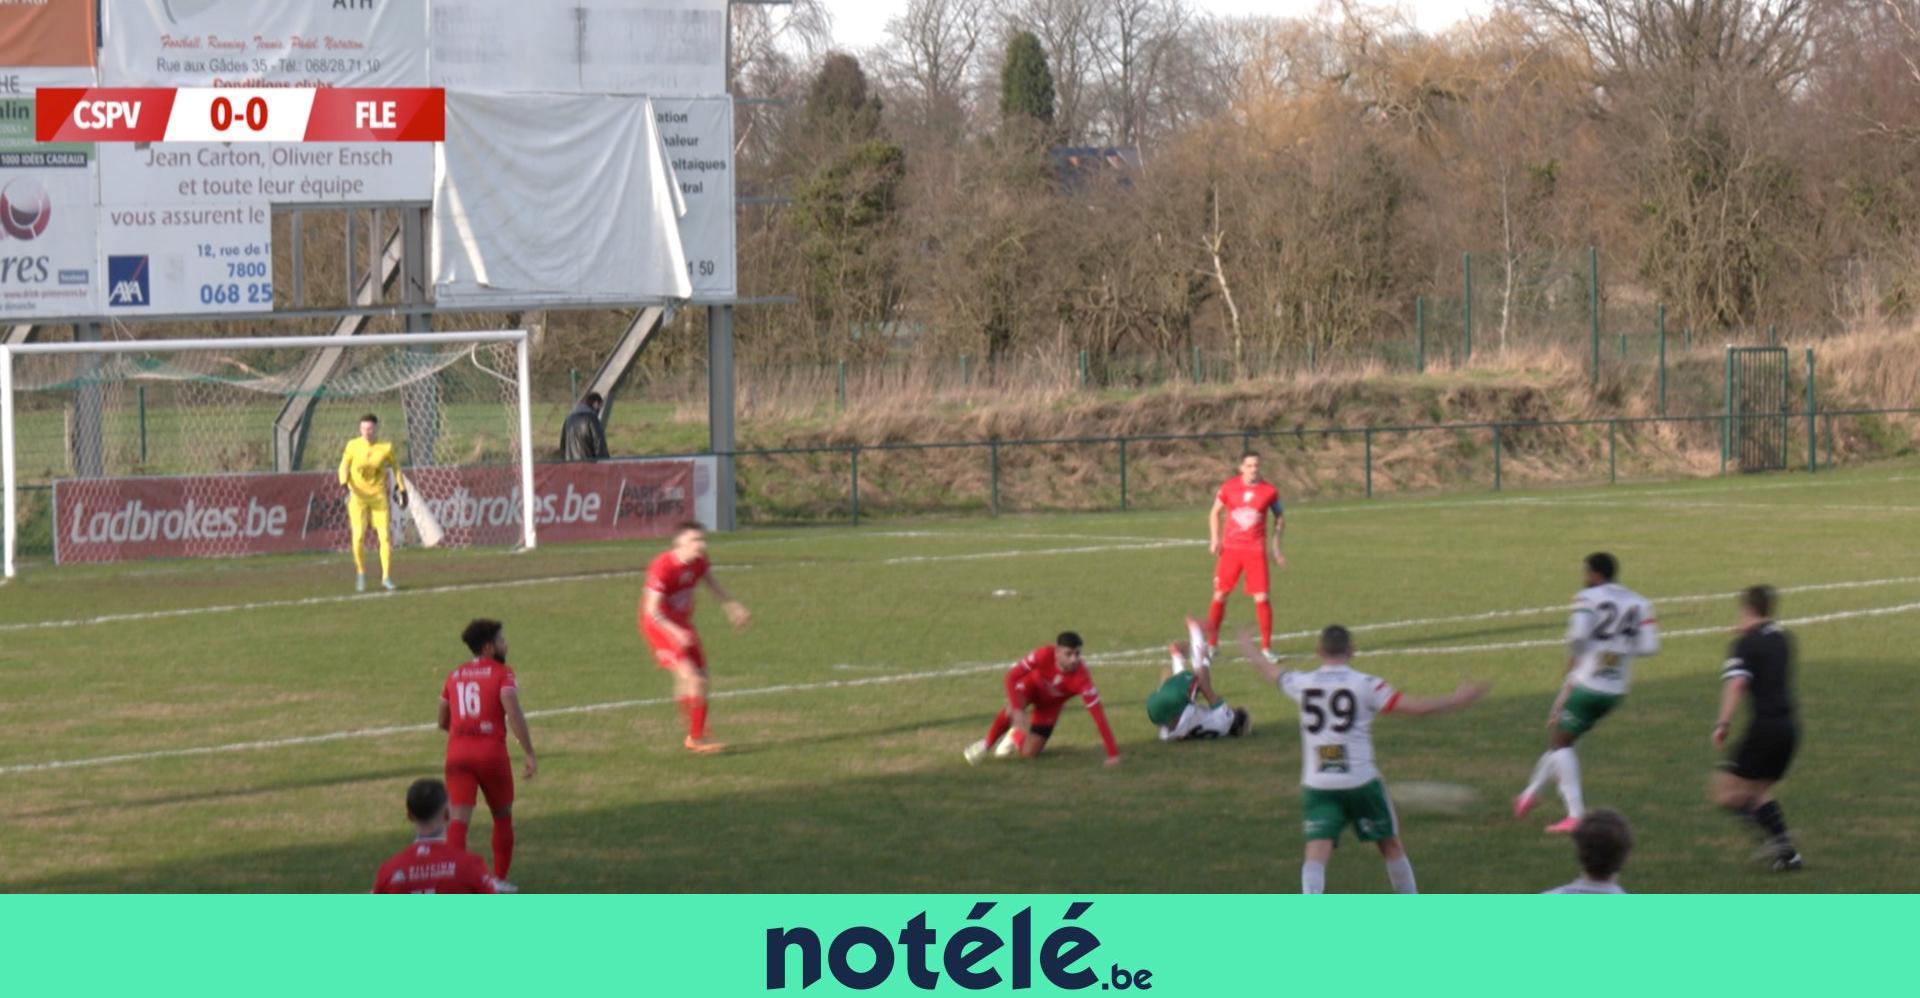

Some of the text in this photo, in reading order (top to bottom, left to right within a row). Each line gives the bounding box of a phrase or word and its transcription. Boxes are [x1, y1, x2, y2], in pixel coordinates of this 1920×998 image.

[156, 57, 181, 73] Rue
[184, 61, 207, 73] aux
[252, 58, 268, 73] 35
[46, 153, 86, 166] CADEAUX
[145, 147, 393, 168] Jean Carton, Olivier Ensch
[178, 174, 364, 198] et toute leur équipe
[111, 205, 265, 227] vous assurent le
[198, 243, 216, 258] 12,
[220, 245, 240, 257] rue
[244, 243, 261, 256] de
[227, 262, 267, 278] 7800
[699, 260, 715, 276] 50
[109, 280, 144, 303] AXA
[200, 283, 273, 304] 068 25
[70, 496, 288, 545] Ladbrokes.be
[1590, 601, 1641, 645] 24
[456, 681, 481, 719] 16
[1302, 688, 1357, 735] 59
